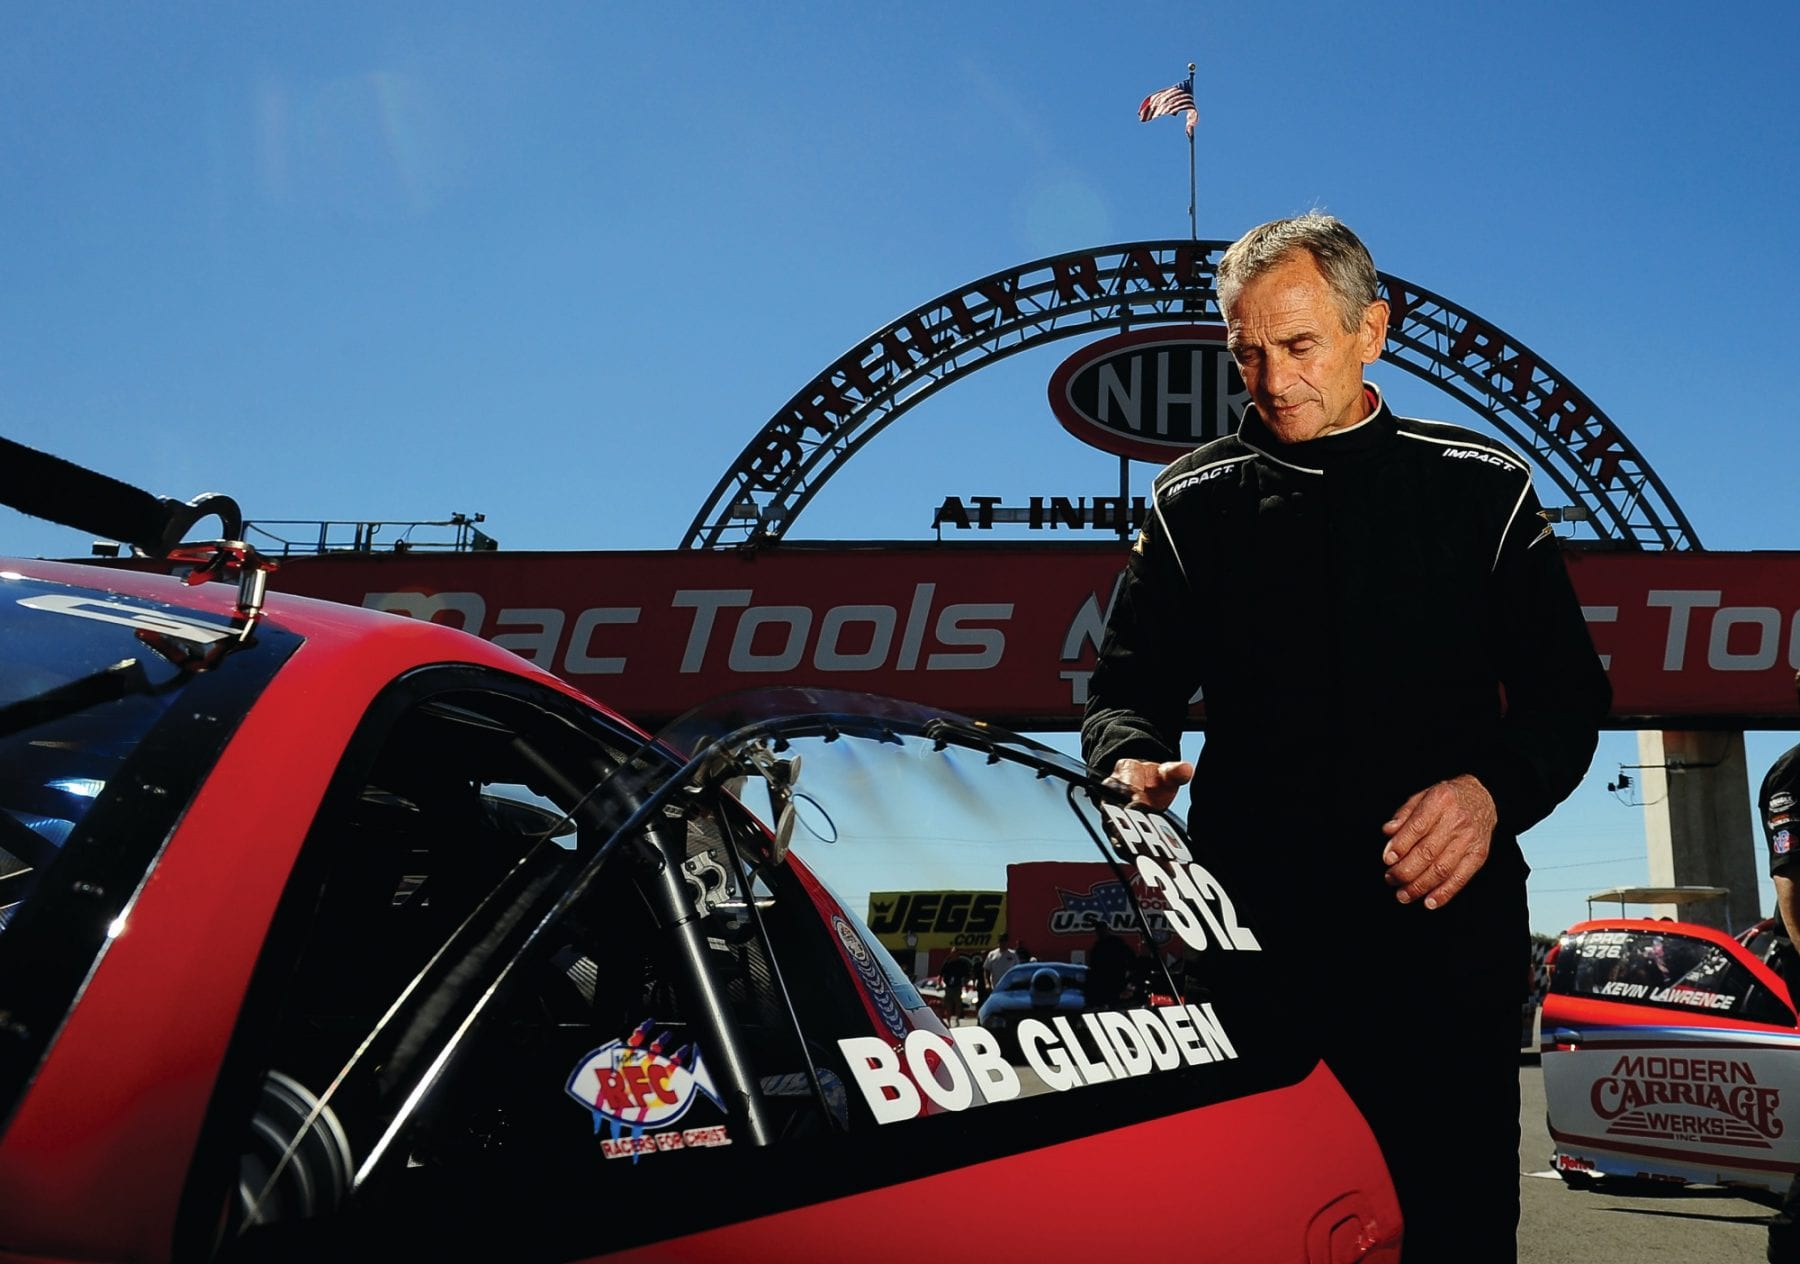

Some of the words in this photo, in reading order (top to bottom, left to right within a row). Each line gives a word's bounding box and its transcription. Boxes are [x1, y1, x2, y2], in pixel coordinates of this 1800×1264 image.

[1098, 351, 1252, 436] NHR
[1449, 308, 1639, 488] PARK
[931, 496, 1003, 530] AT
[1029, 496, 1146, 530] INDI
[671, 583, 1013, 671] Tools
[1103, 803, 1193, 863] PRO
[872, 894, 1003, 933] JEGS
[1136, 855, 1262, 951] 312
[1601, 981, 1649, 999] KEVIN
[1649, 986, 1736, 1010] LAWRENCE
[594, 1064, 679, 1110] RFC
[838, 1026, 1021, 1125] BOB
[1016, 1003, 1239, 1092] GLIDDEN
[1611, 1055, 1757, 1085] MODERN
[1590, 1077, 1784, 1139] CARRIAGE
[1647, 1112, 1724, 1136] WERKS
[601, 1136, 657, 1157] RACERS
[656, 1133, 684, 1150] FOR
[684, 1127, 729, 1146] CHRIST
[1675, 1134, 1700, 1142] INC.
